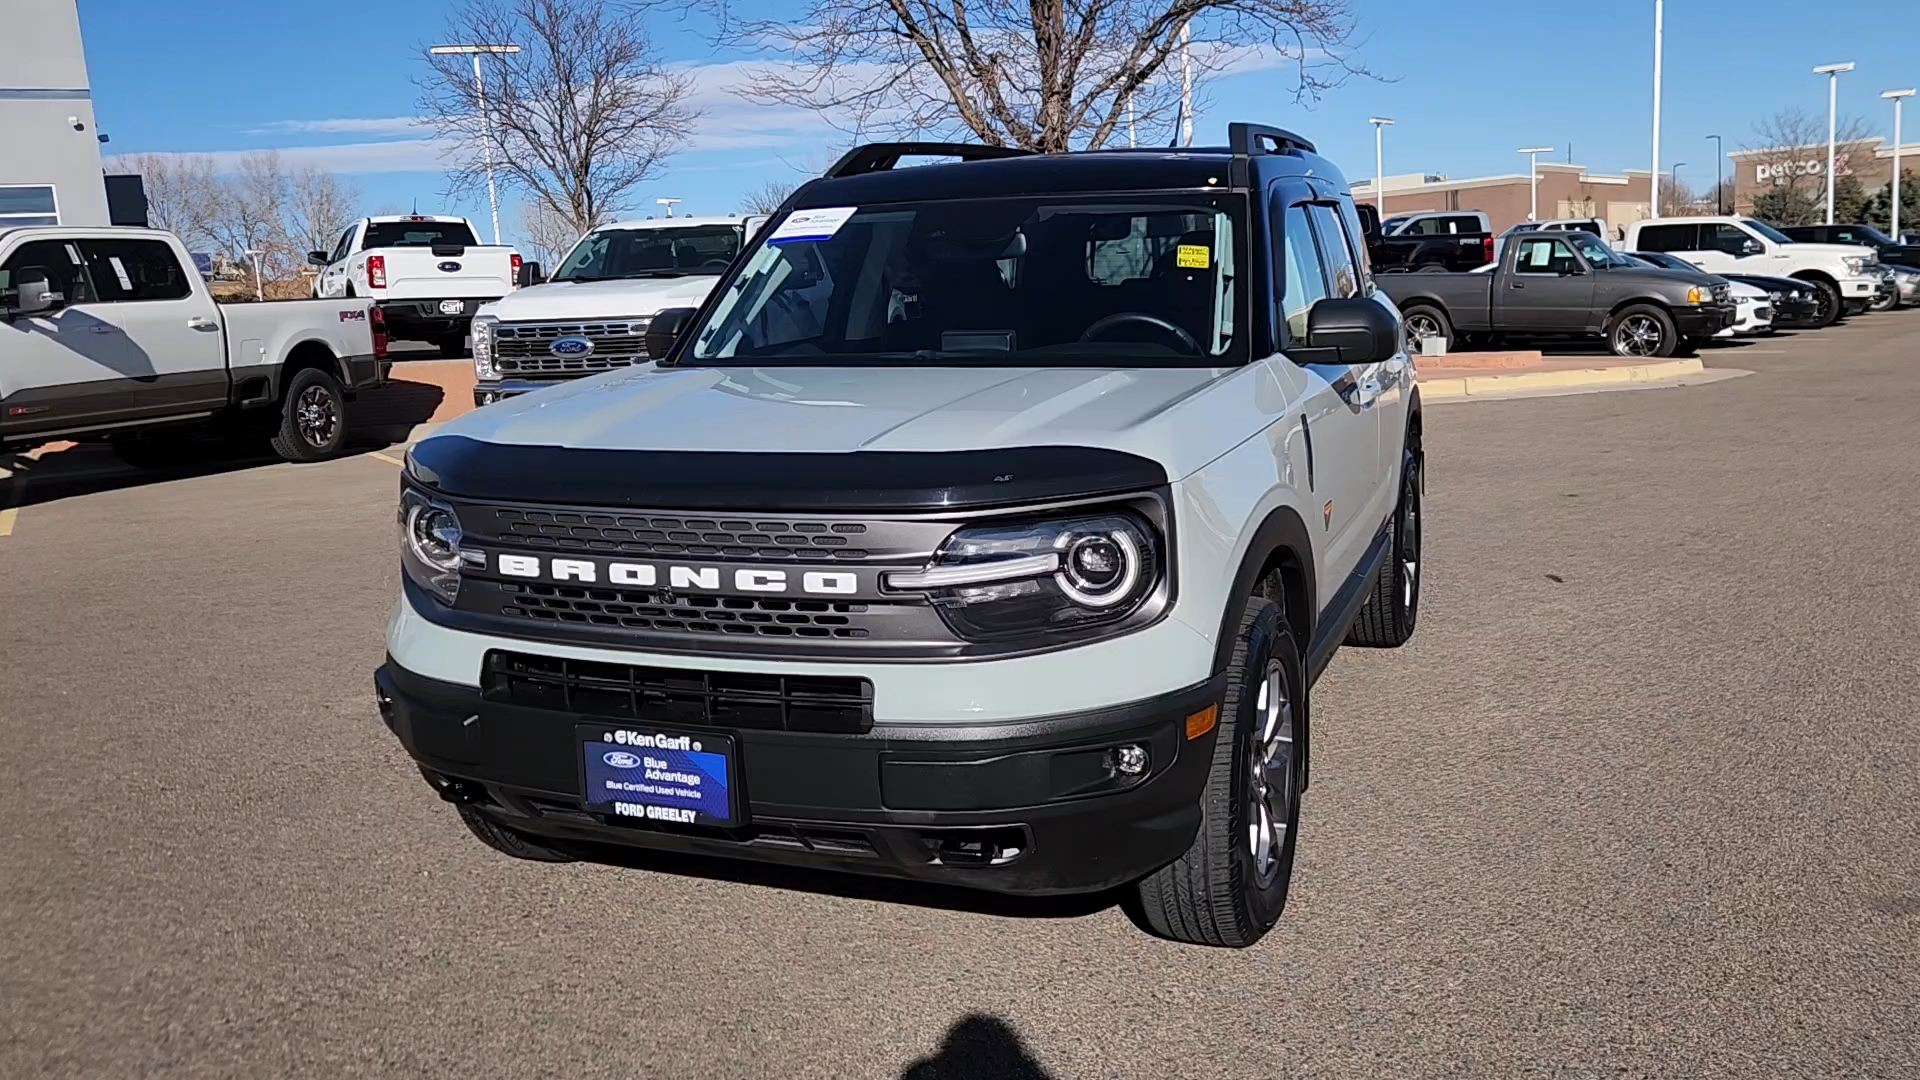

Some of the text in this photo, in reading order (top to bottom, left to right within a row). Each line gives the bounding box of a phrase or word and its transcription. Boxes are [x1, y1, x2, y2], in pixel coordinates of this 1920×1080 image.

[498, 553, 858, 594] BRONCO
[655, 734, 690, 751] Garff
[643, 756, 668, 769] Blue
[644, 769, 701, 786] Advantage
[605, 780, 702, 799] Blue Certified Used Vehicle
[615, 801, 696, 823] FORD GREELEY
